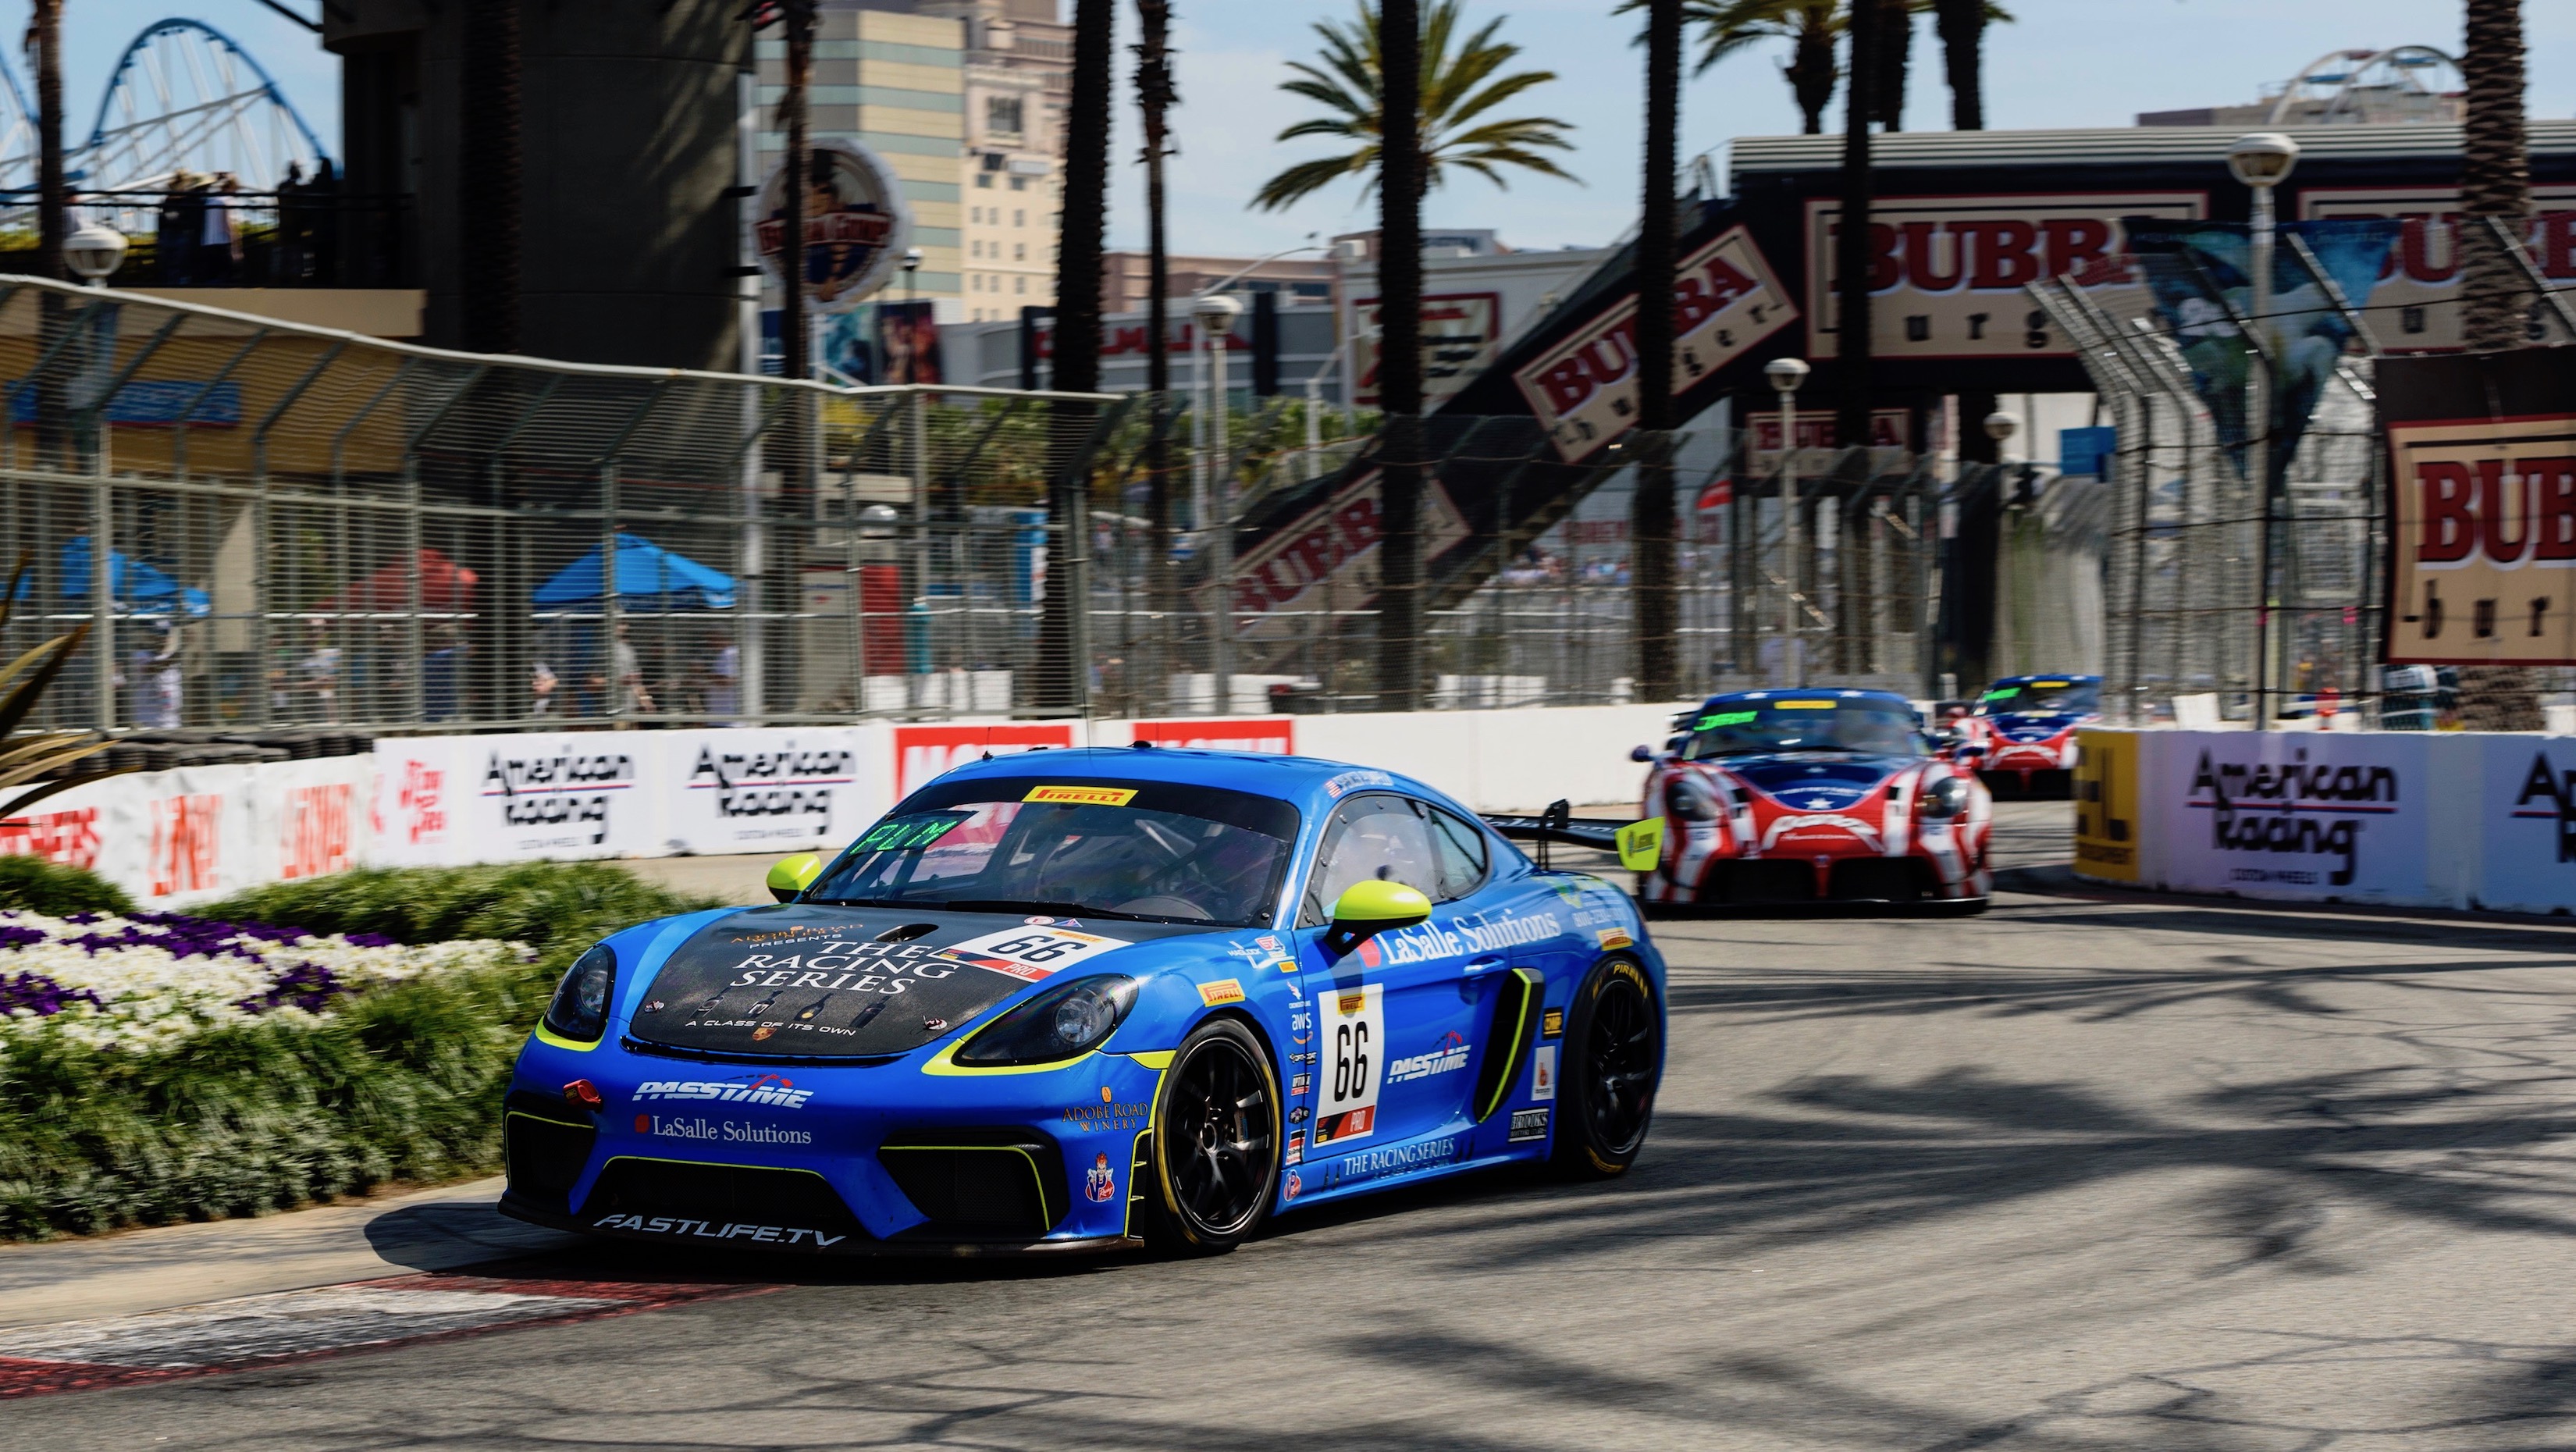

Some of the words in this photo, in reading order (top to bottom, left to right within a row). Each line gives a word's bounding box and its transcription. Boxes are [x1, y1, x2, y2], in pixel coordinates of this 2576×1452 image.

[1829, 216, 2140, 290] BUBB
[1535, 255, 1758, 416] BUBA
[481, 746, 635, 787] American
[690, 741, 857, 781] American
[2189, 746, 2399, 803] American
[717, 783, 831, 836] Racing
[1034, 789, 1125, 803] PIRELLI
[503, 788, 610, 845] Racing
[2213, 795, 2359, 886] Racing
[749, 934, 842, 948] PRESENTS
[817, 941, 932, 959] THE
[987, 935, 1087, 963] 66
[1375, 919, 1464, 965] LaSalle
[1451, 908, 1561, 953] Solutions
[732, 953, 960, 979] RACING
[1002, 963, 1037, 977] PRO
[730, 970, 916, 995] SERIES
[1203, 983, 1242, 1002] PIRELLI
[788, 1023, 814, 1031] ITS
[819, 1026, 856, 1037] OWN
[1292, 1012, 1312, 1031] aws
[1334, 1021, 1368, 1102] 66
[632, 1081, 814, 1109] PASSTIME
[1062, 1105, 1110, 1123] ADOBE
[1113, 1102, 1148, 1118] ROAD
[1079, 1119, 1137, 1133] WINERY
[1350, 1109, 1366, 1132] PRO
[653, 1115, 717, 1141] LaSalle
[723, 1121, 812, 1144] Solutions
[1343, 1155, 1368, 1176] THE
[1370, 1144, 1417, 1171] RACING
[1416, 1137, 1455, 1162] SERIES
[593, 1213, 847, 1247] FASTLIFE.TV
